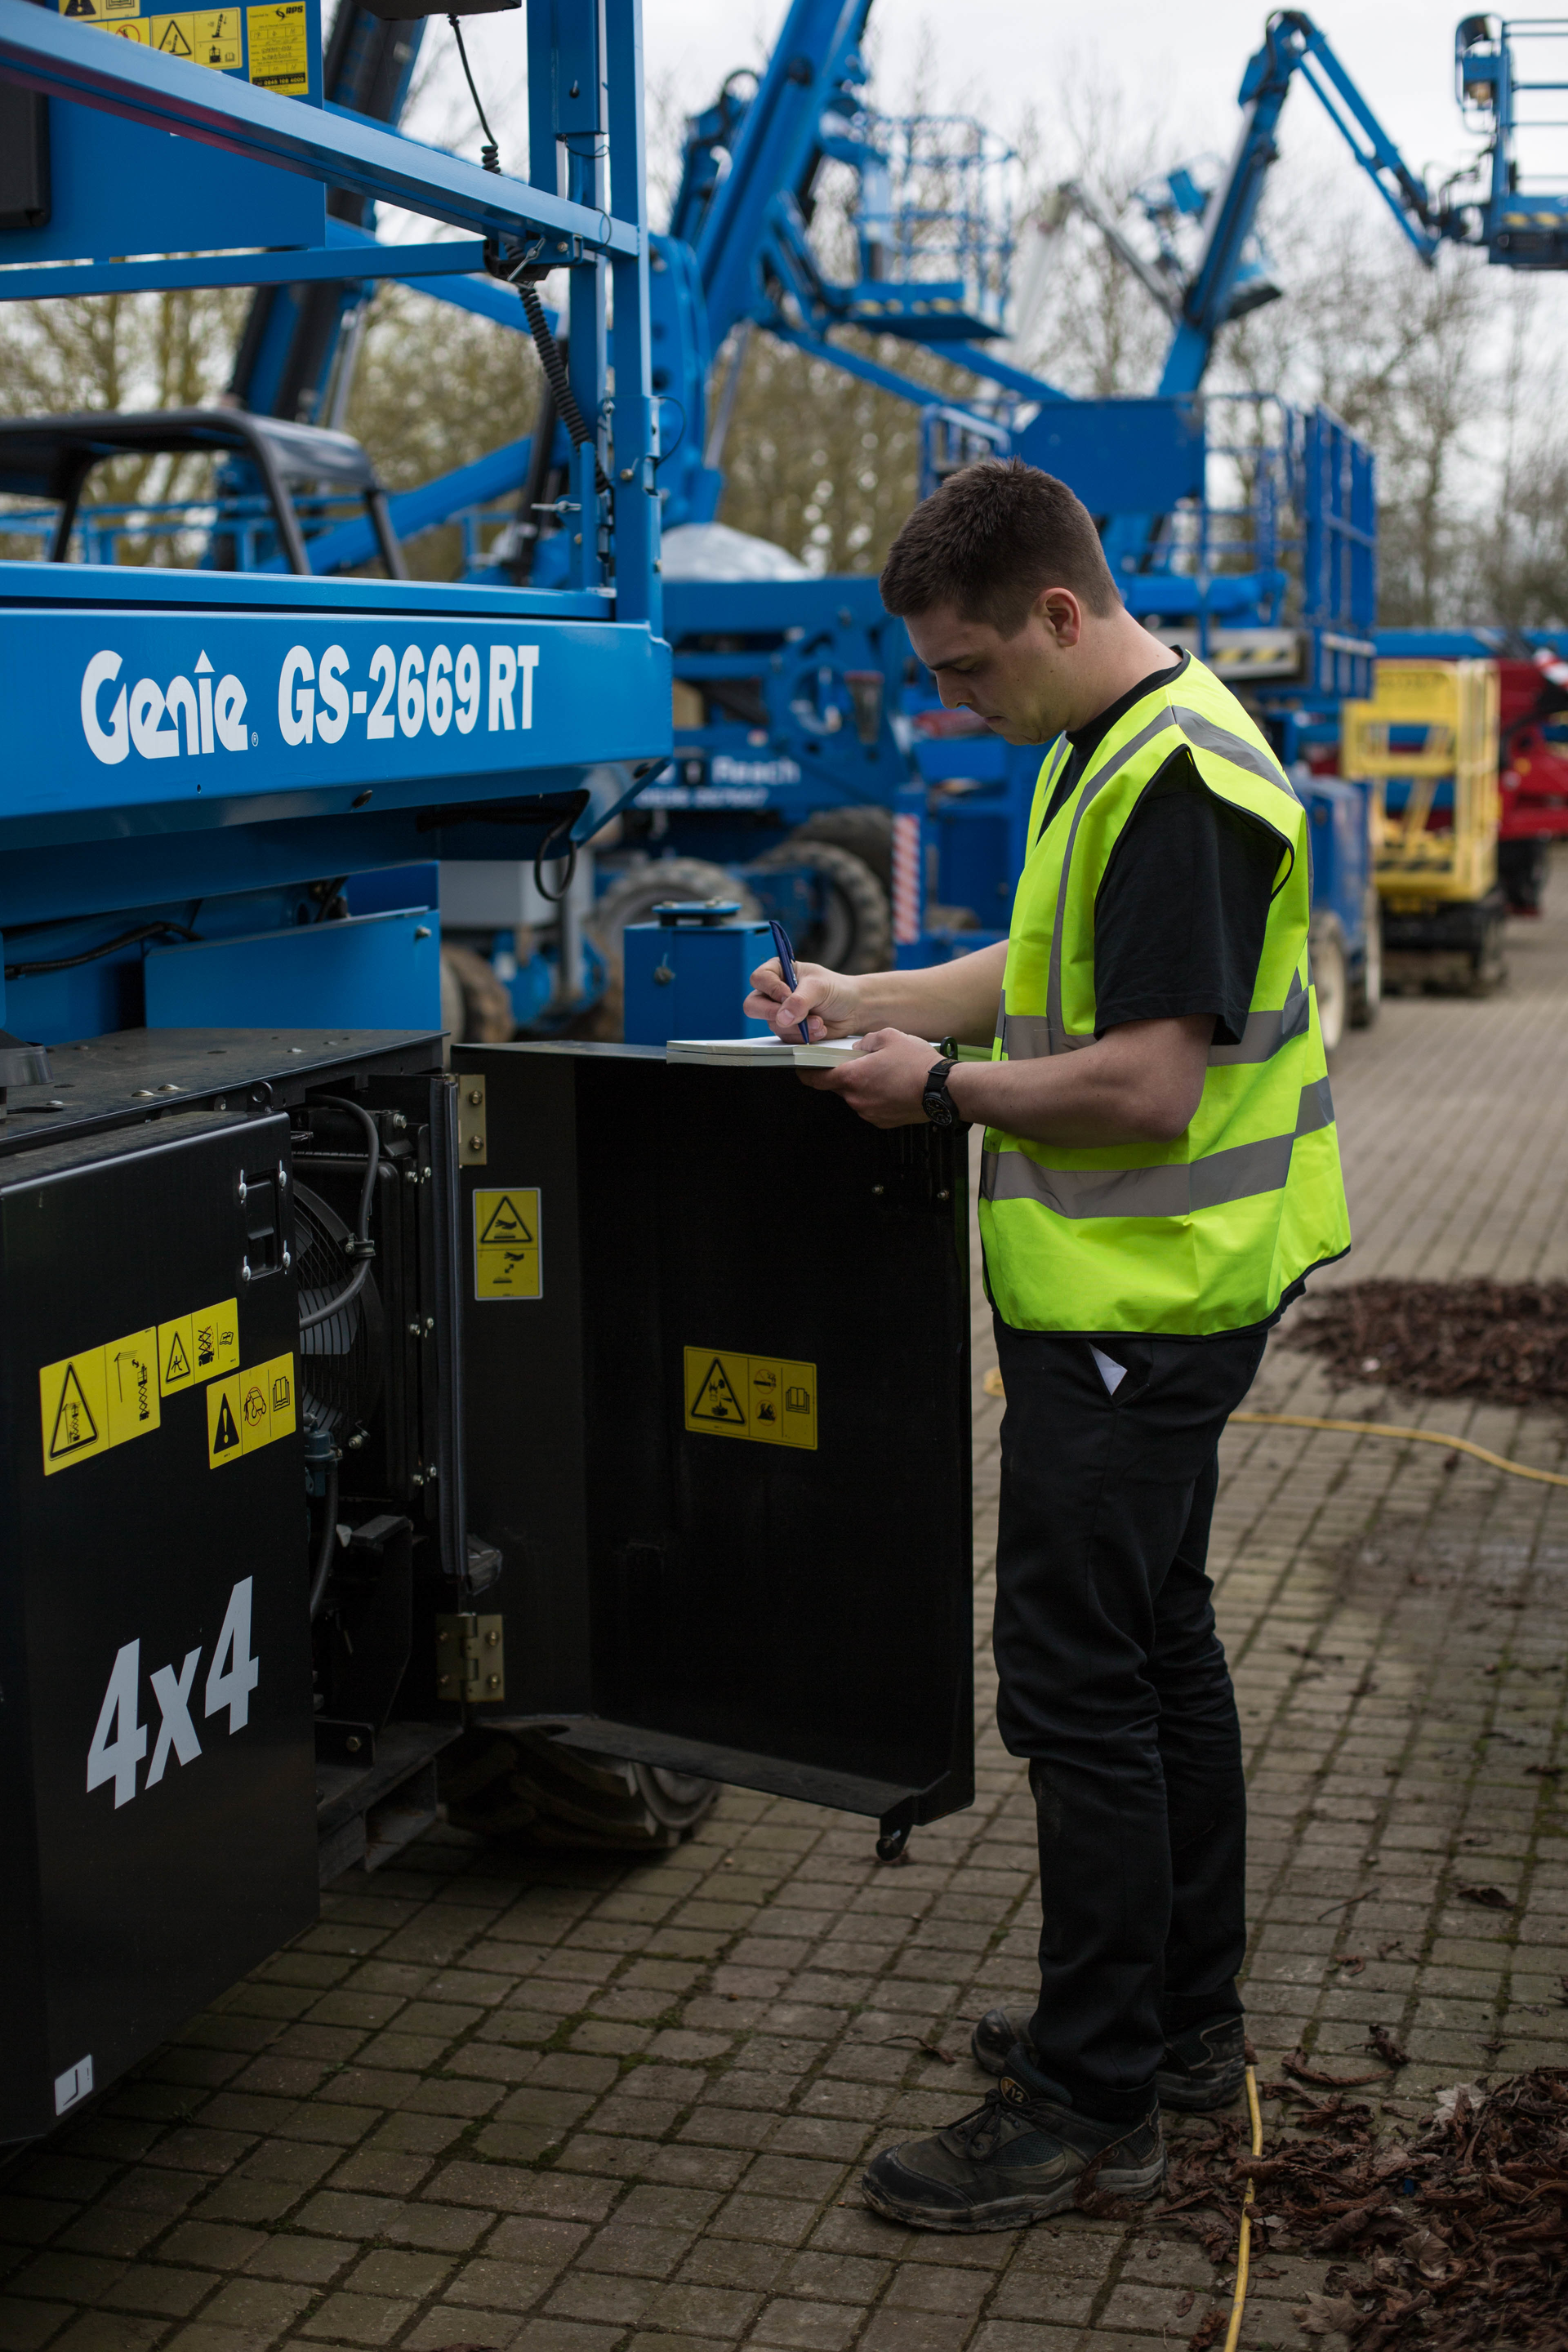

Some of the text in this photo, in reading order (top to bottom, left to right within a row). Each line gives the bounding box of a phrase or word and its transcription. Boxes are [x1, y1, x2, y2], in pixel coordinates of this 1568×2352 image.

[286, 5, 303, 14] APS
[81, 644, 540, 765] Genie GS-2669 RT
[86, 1575, 260, 1810] 4x4
